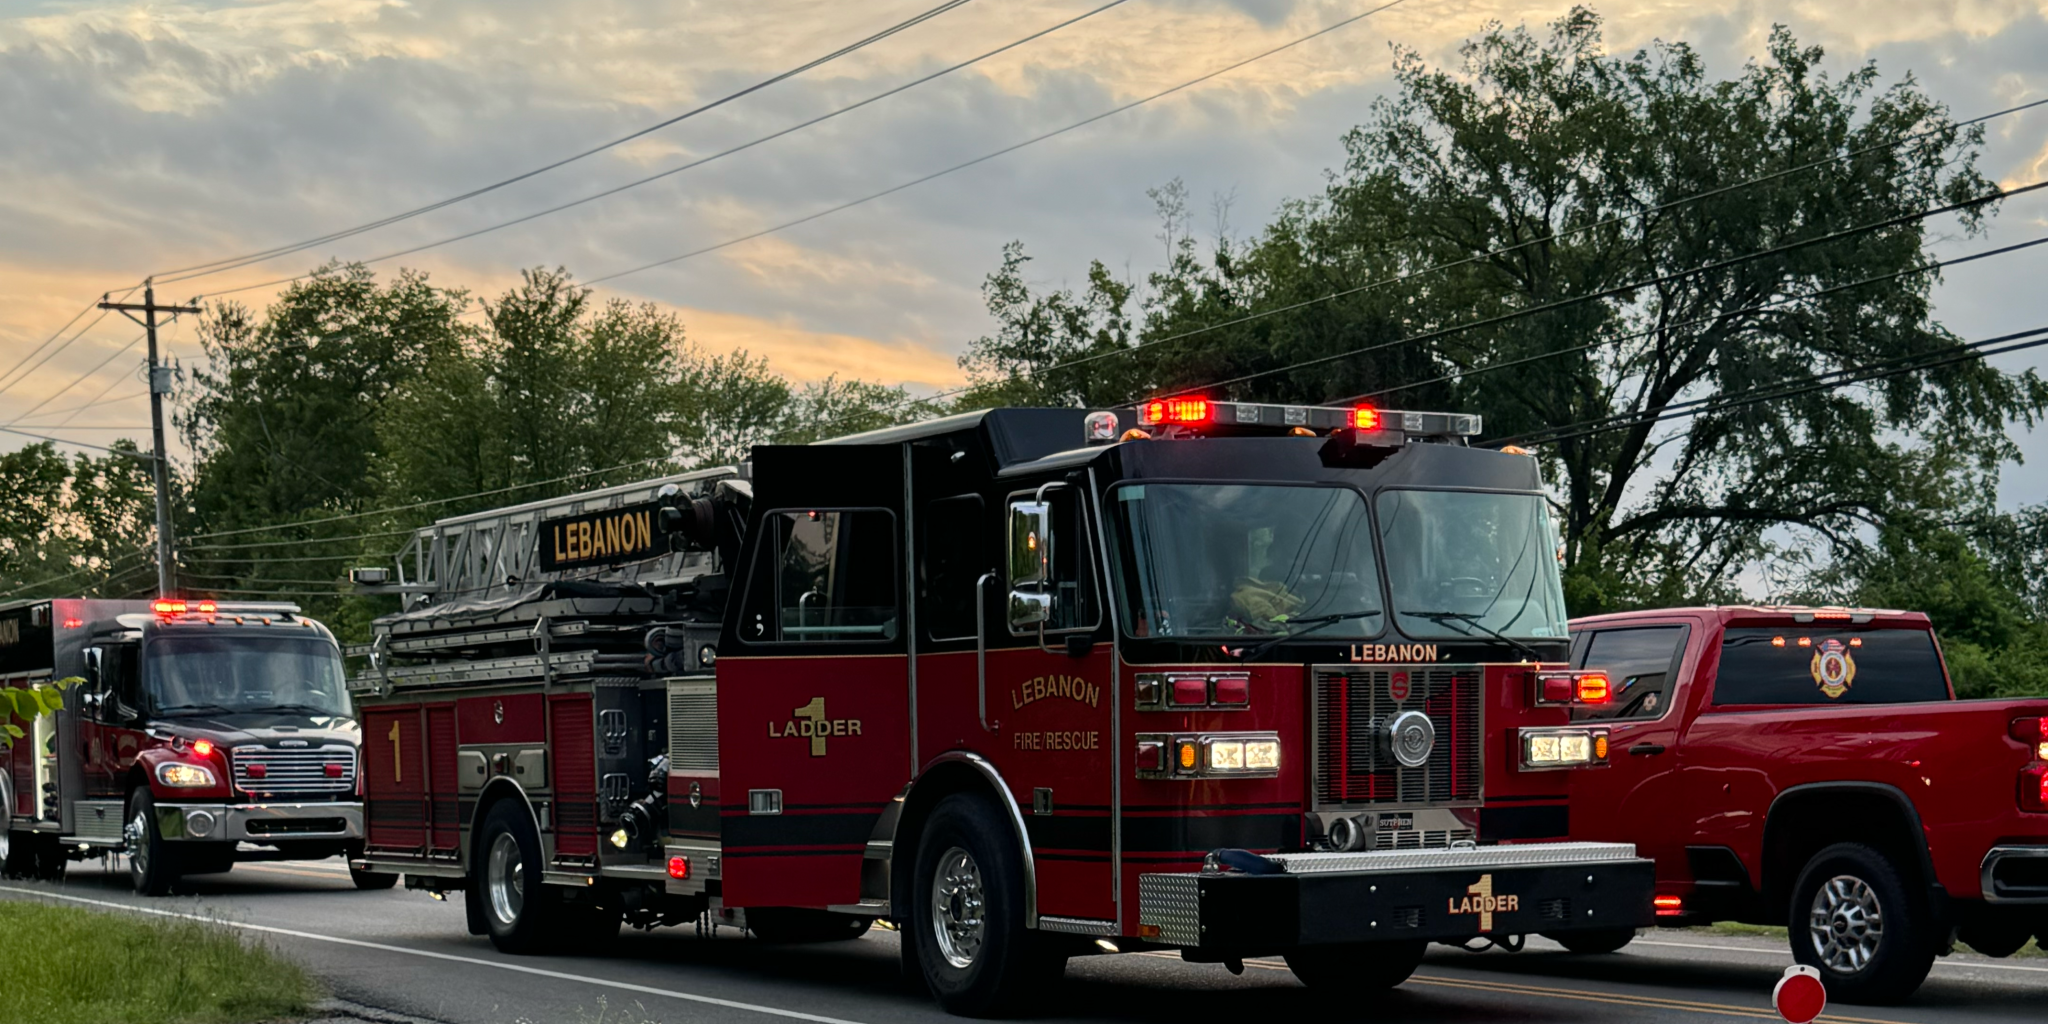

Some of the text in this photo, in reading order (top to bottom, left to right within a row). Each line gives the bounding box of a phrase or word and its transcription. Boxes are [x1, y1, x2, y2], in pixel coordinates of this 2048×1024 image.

[554, 510, 651, 562] LEBANON
[1351, 643, 1437, 662] LEBANON
[1011, 674, 1100, 710] LEBANON
[1391, 672, 1409, 699] S
[769, 719, 862, 738] LADDER
[794, 697, 826, 756] 1
[1014, 731, 1099, 750] FIRE/RESCUE
[388, 720, 401, 782] 1
[1449, 895, 1519, 914] LADDER
[1468, 874, 1492, 931] 1
